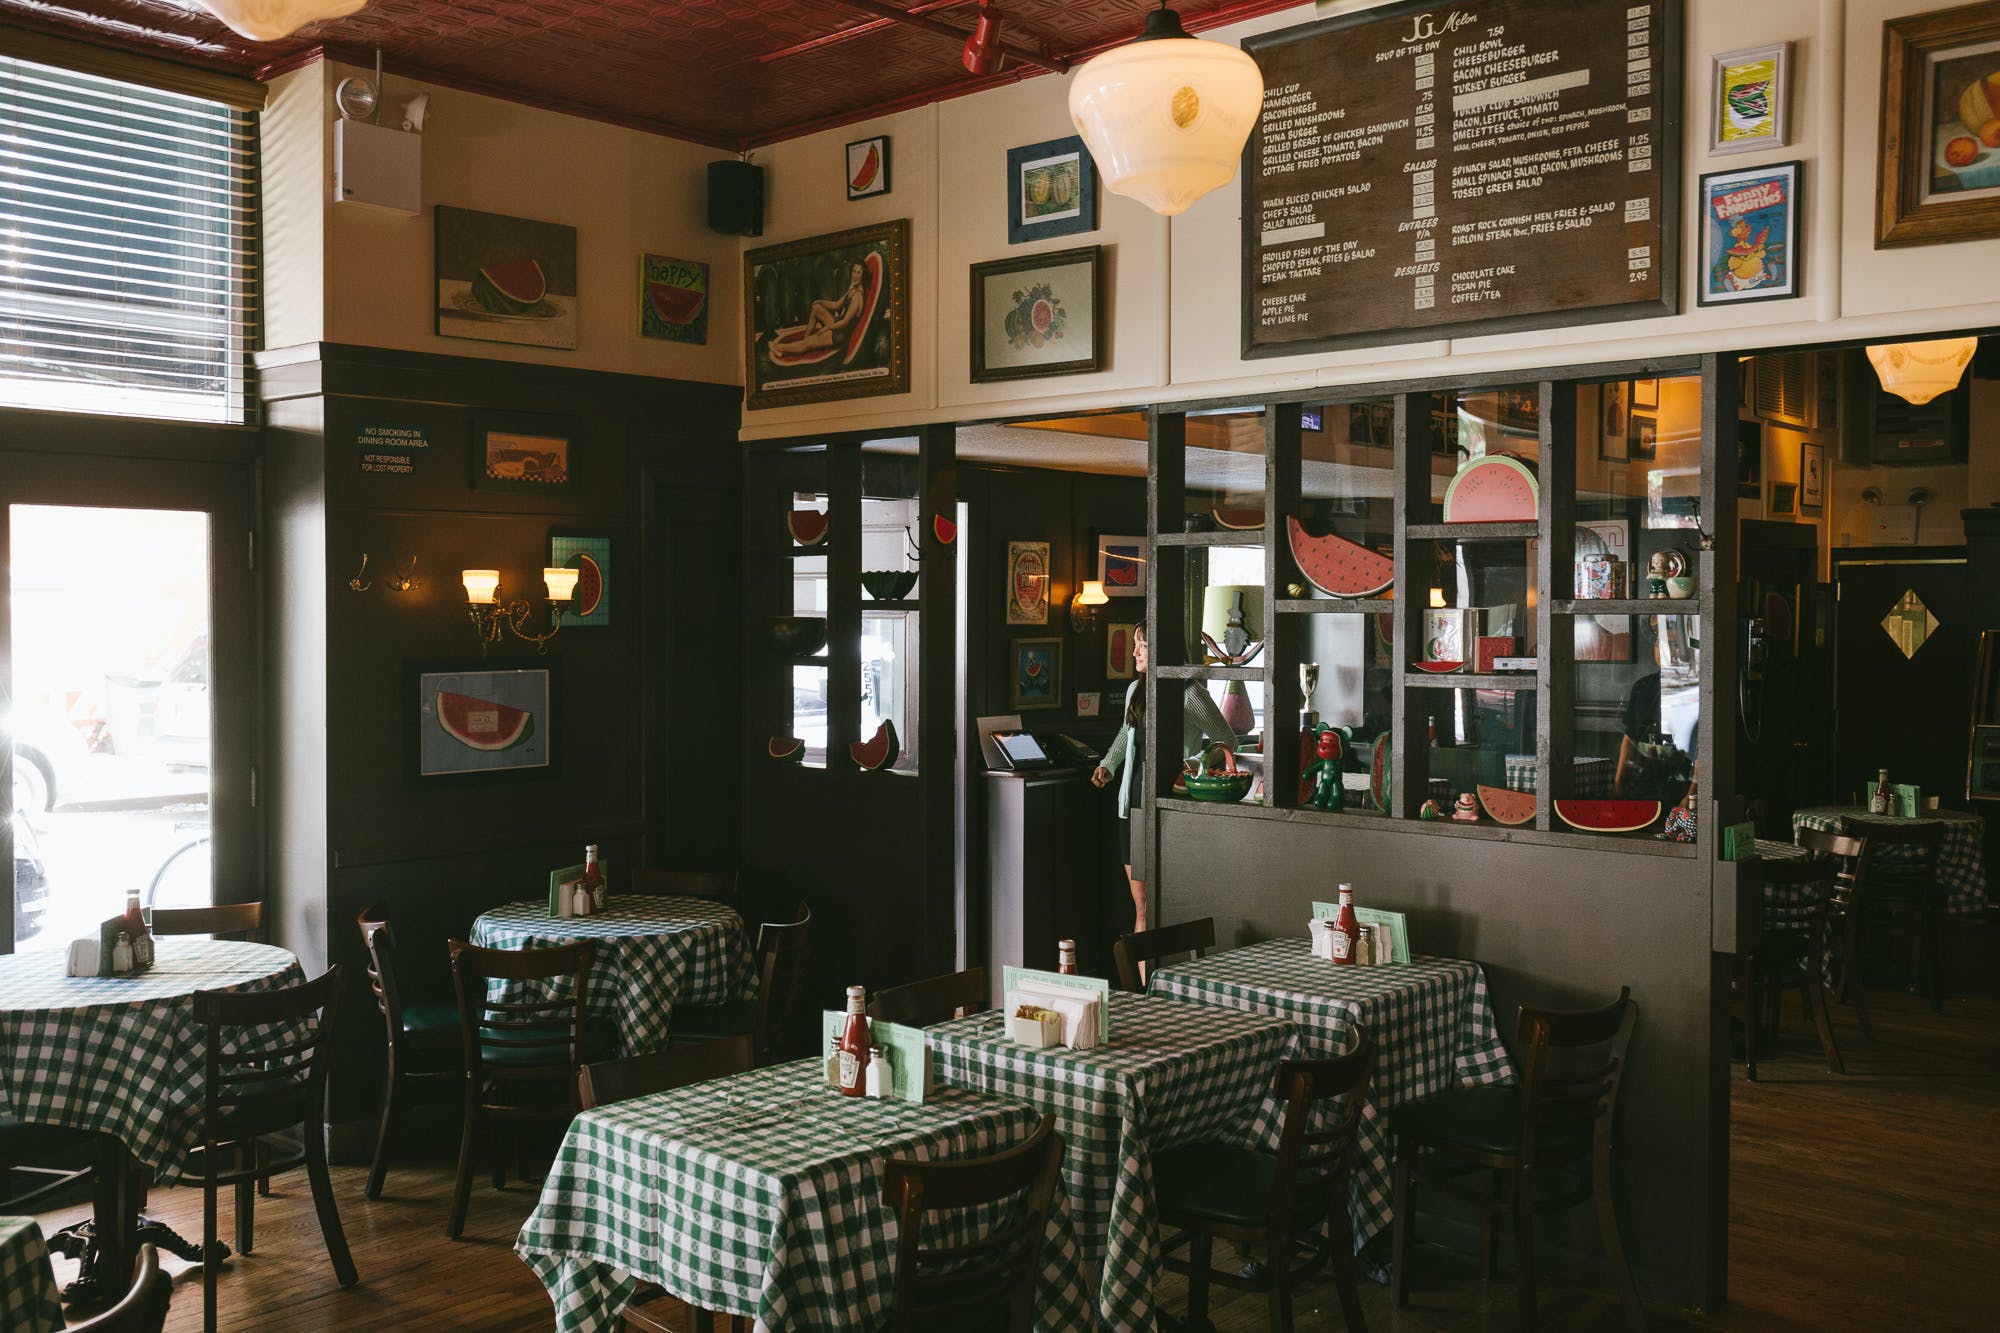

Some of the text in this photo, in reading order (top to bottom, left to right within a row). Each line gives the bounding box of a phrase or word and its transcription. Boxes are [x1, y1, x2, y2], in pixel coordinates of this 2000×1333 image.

[1402, 10, 1478, 43] JG Melon
[1487, 25, 1505, 38] 7.50
[1375, 40, 1441, 63] SOUP OF THE DAY
[1453, 38, 1504, 57] CHILI BOWL
[1453, 44, 1526, 68] CHEESEBURGER
[1453, 66, 1482, 82] BACON
[1484, 50, 1559, 75] CHEESEBURGER
[1263, 83, 1300, 98] CHILI CUP
[1453, 71, 1527, 94] TURKEY BURGER
[1263, 91, 1312, 109] HAMBURGER
[1415, 103, 1434, 115] 12.50
[1263, 102, 1317, 122] BACONBURGER
[1263, 109, 1345, 133] GRILLED MUSHROOMS
[1453, 101, 1559, 131] BACON, LETTUCE, TOMATO
[1263, 119, 1409, 155] GRILLED BREAST OF CHICKEN SANDWICH
[1264, 126, 1318, 144] TUNA BURGER
[1416, 125, 1434, 137] 11.25
[1453, 123, 1505, 142] OMELETTES
[1629, 134, 1649, 146] 11.25
[1263, 135, 1383, 165] GRILLED CHEESE, TOMATO, BACON
[1452, 139, 1620, 177] SPINACH SALAD, MUSHROOMS, FETA CHEESE
[1263, 151, 1360, 176] COTTAGE FRIED POTATOES
[1403, 159, 1438, 173] SALADS
[1452, 150, 1623, 189] SMALL SPINACH SALAD, BACON, MUSHROOMS
[1263, 183, 1371, 208] WARM SLICED CHICKEN SALAD
[1452, 177, 1543, 200] TOSSED GREEN SALAD
[1723, 184, 1770, 206] Funny
[1263, 204, 1313, 220] CHEF'S SALAD
[1452, 202, 1616, 234] ROAST ROCK CORNISH HEN, FRIES & SALAD
[1263, 214, 1316, 231] SALAD NICOISE
[1398, 217, 1439, 233] ENTREES
[1452, 233, 1484, 246] SIRLOIN
[1485, 229, 1511, 241] STEAK
[1531, 221, 1555, 234] FRIES
[1556, 222, 1564, 231] &
[1565, 217, 1592, 229] SALAD
[1416, 229, 1431, 240] P/A
[1263, 240, 1358, 262] BROILED FISH OF THE DAY
[1263, 260, 1295, 273] CHOPPED
[1322, 253, 1342, 264] FRIES
[1344, 254, 1350, 262] &
[1351, 249, 1376, 260] SALAD
[1394, 262, 1440, 277] DESSERTS
[1262, 267, 1322, 284] STEAK TARTARE
[1452, 265, 1516, 282] CHOCOLATE CAKE
[1629, 271, 1648, 283] 2.95
[1452, 280, 1491, 292] PECAN PIE
[1262, 293, 1307, 306] CHEESE CAKE
[1452, 290, 1501, 304] COFFEE/TEA
[1262, 305, 1295, 316] APPLE PIE
[1262, 313, 1309, 326] KEY LIME PIE
[365, 427, 421, 438] NO SMOKING IN
[358, 436, 428, 448] DINING ROOM AREA
